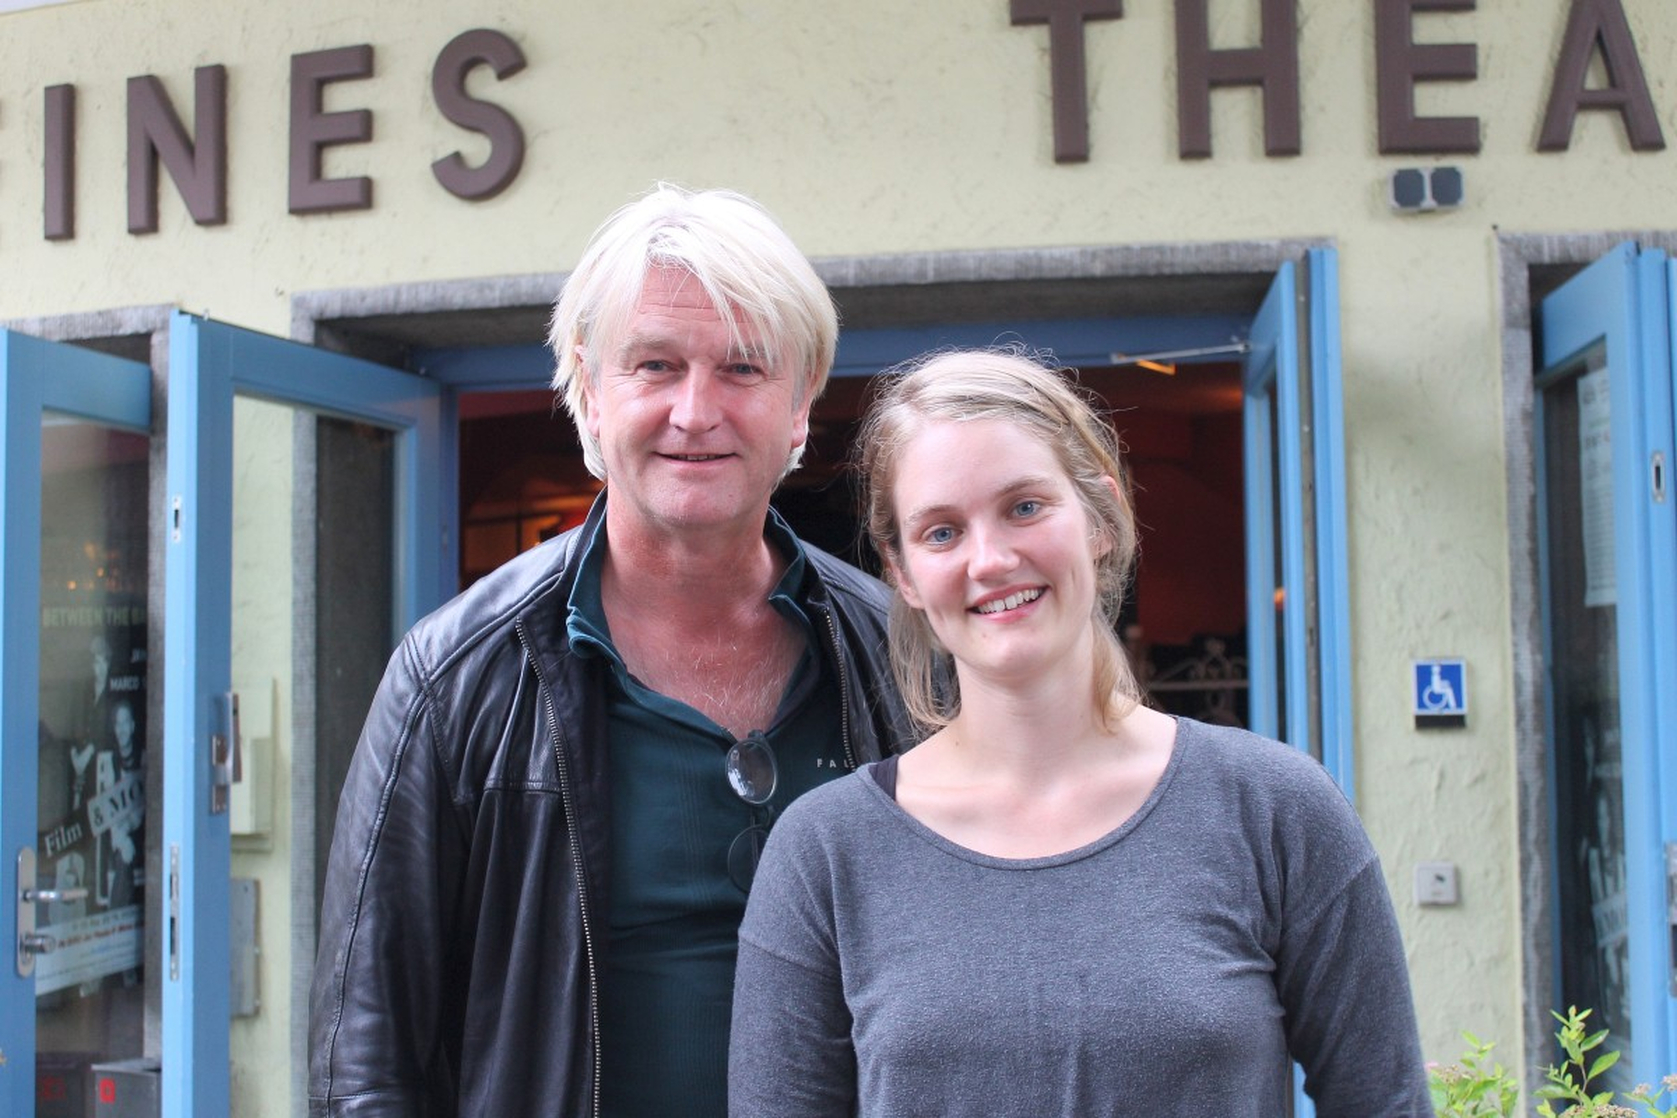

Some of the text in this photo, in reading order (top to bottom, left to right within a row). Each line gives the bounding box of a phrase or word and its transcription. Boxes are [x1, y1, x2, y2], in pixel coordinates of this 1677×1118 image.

[0, 0, 1666, 242] INES THEA
[43, 606, 103, 627] BETWEEN
[105, 606, 129, 627] THE
[44, 822, 83, 858] Film
